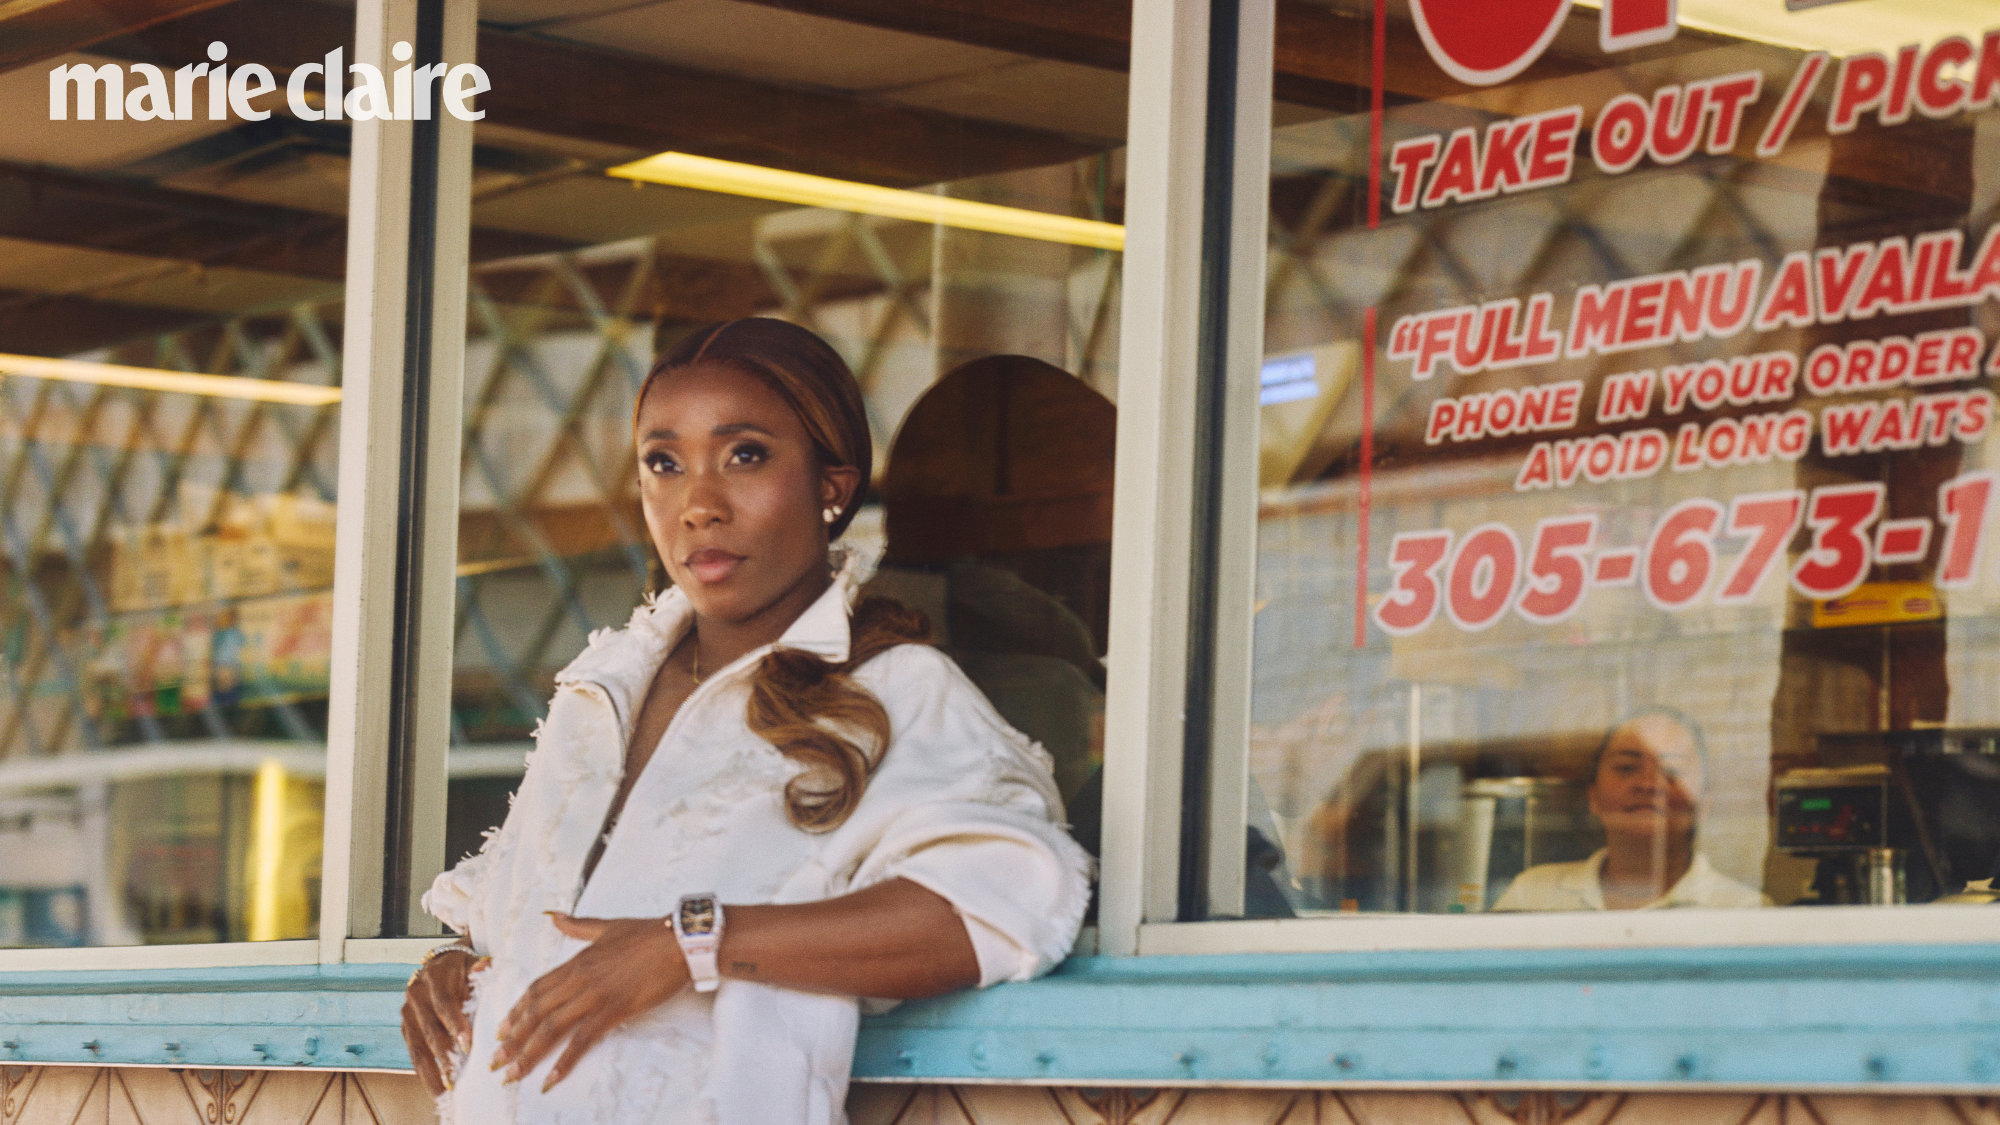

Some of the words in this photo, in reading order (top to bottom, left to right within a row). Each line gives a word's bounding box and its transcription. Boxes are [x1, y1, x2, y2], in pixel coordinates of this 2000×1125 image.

[1391, 106, 1584, 212] TAKE
[1591, 71, 1763, 174] OUT
[1756, 50, 1830, 156] /
[1566, 259, 1763, 357] MENU
[1426, 380, 1585, 445] PHONE
[1597, 369, 1658, 424] IN
[1663, 350, 1797, 414] YOUR
[1803, 327, 1985, 397] ORDER
[1515, 428, 1668, 491] AVOID
[1672, 409, 1812, 472] LONG
[1822, 388, 1996, 457] WAITS
